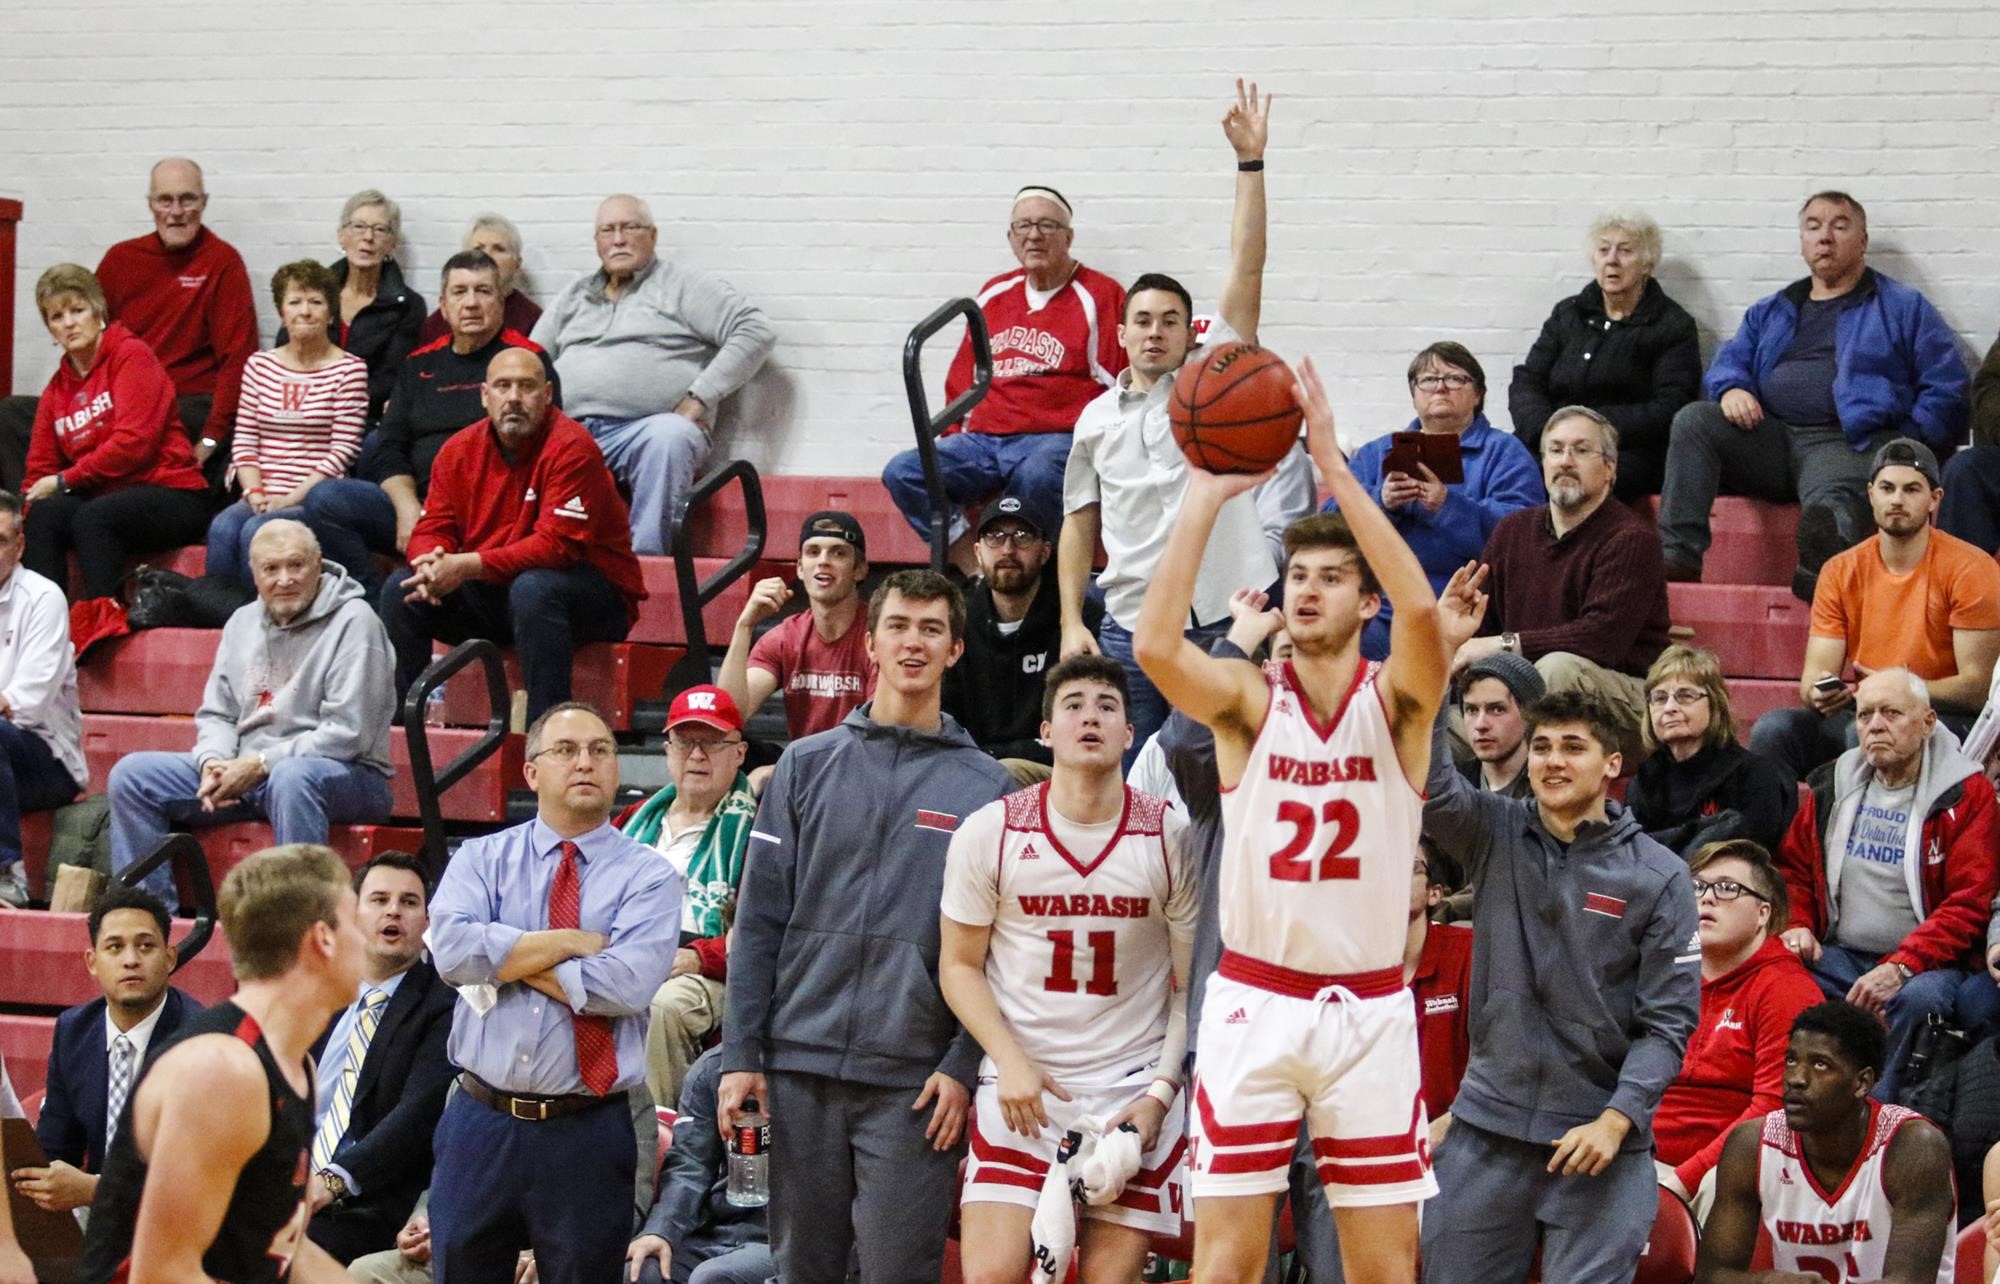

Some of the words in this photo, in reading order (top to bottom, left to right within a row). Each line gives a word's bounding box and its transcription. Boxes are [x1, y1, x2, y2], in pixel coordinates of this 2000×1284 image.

[281, 383, 312, 412] W
[1268, 753, 1378, 786] WABASH
[1269, 798, 1361, 882] 22
[1018, 894, 1151, 918] WABASH
[1044, 930, 1118, 997] 11
